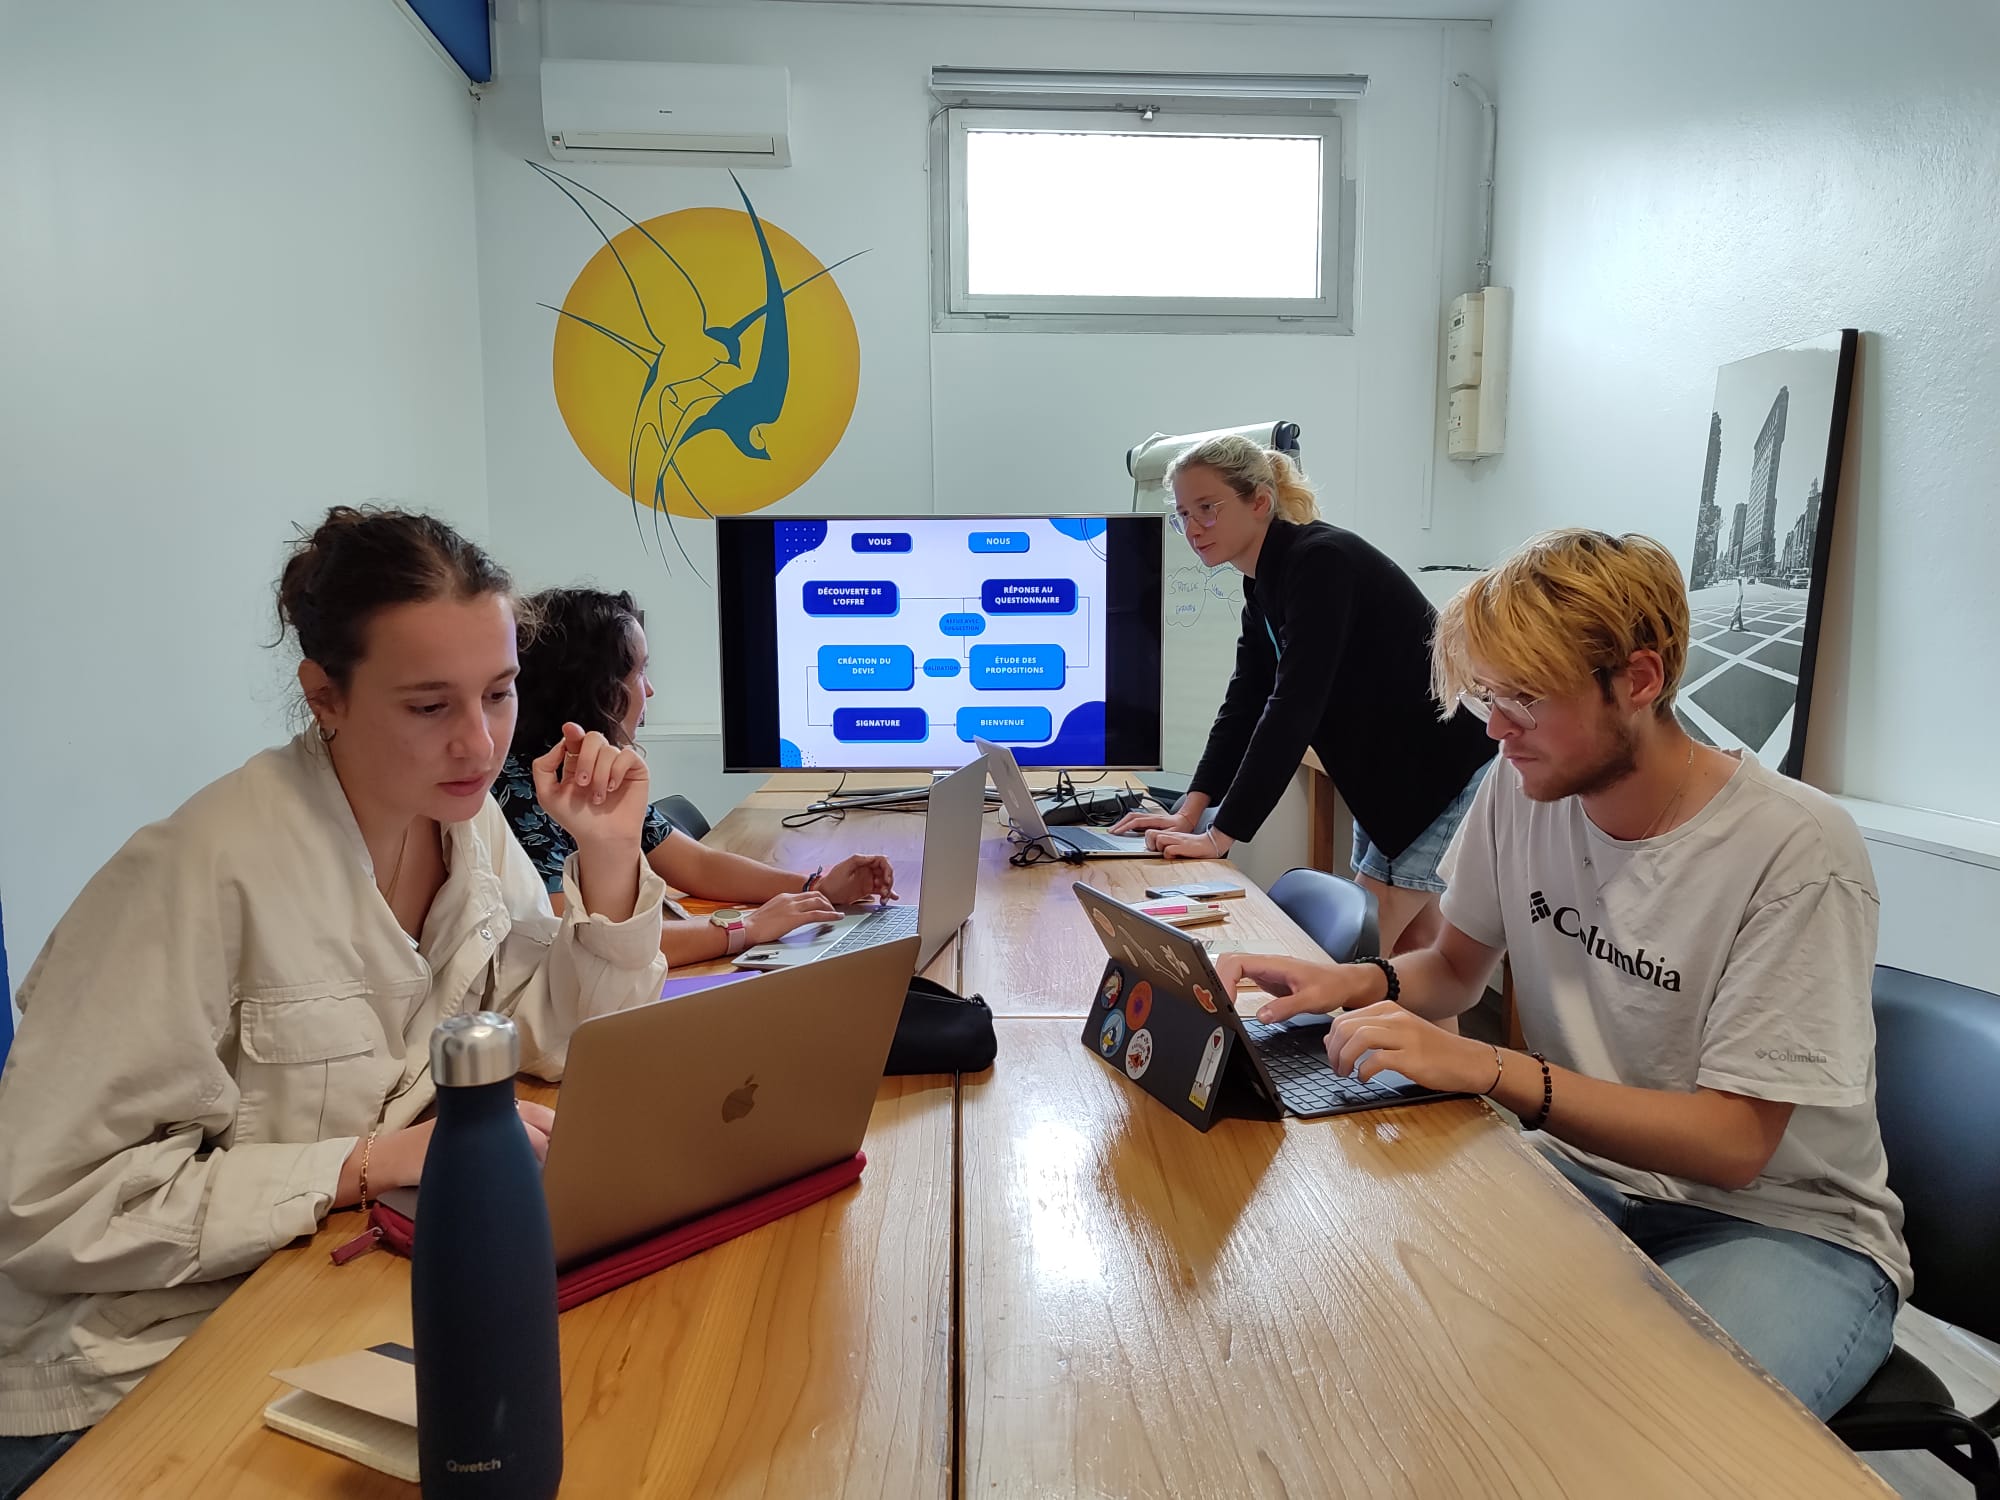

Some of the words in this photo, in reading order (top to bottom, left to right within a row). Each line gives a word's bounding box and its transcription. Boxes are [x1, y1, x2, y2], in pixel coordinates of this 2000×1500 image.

[867, 537, 892, 546] VOUS
[986, 537, 1011, 545] NOUS
[817, 586, 868, 595] DÉCOUVERTE
[870, 587, 882, 595] DE
[1003, 585, 1039, 594] RÉPONSE
[1041, 586, 1054, 594] AU
[833, 598, 865, 606] L'OFFRE
[994, 596, 1060, 605] QUESTIONNAIRE
[837, 656, 877, 666] CRÉATION
[879, 657, 891, 665] DU
[994, 655, 1019, 664] ÉTUDE
[1021, 656, 1038, 664] DES
[852, 667, 875, 675] DEVIS
[985, 667, 1044, 675] PROPOSITIONS
[855, 719, 901, 728] SIGNATURE
[980, 719, 1025, 727] BIENVENUE
[1553, 906, 1681, 992] Columbia
[1768, 1048, 1827, 1064] Columbia
[445, 1458, 502, 1473] Qwetch
